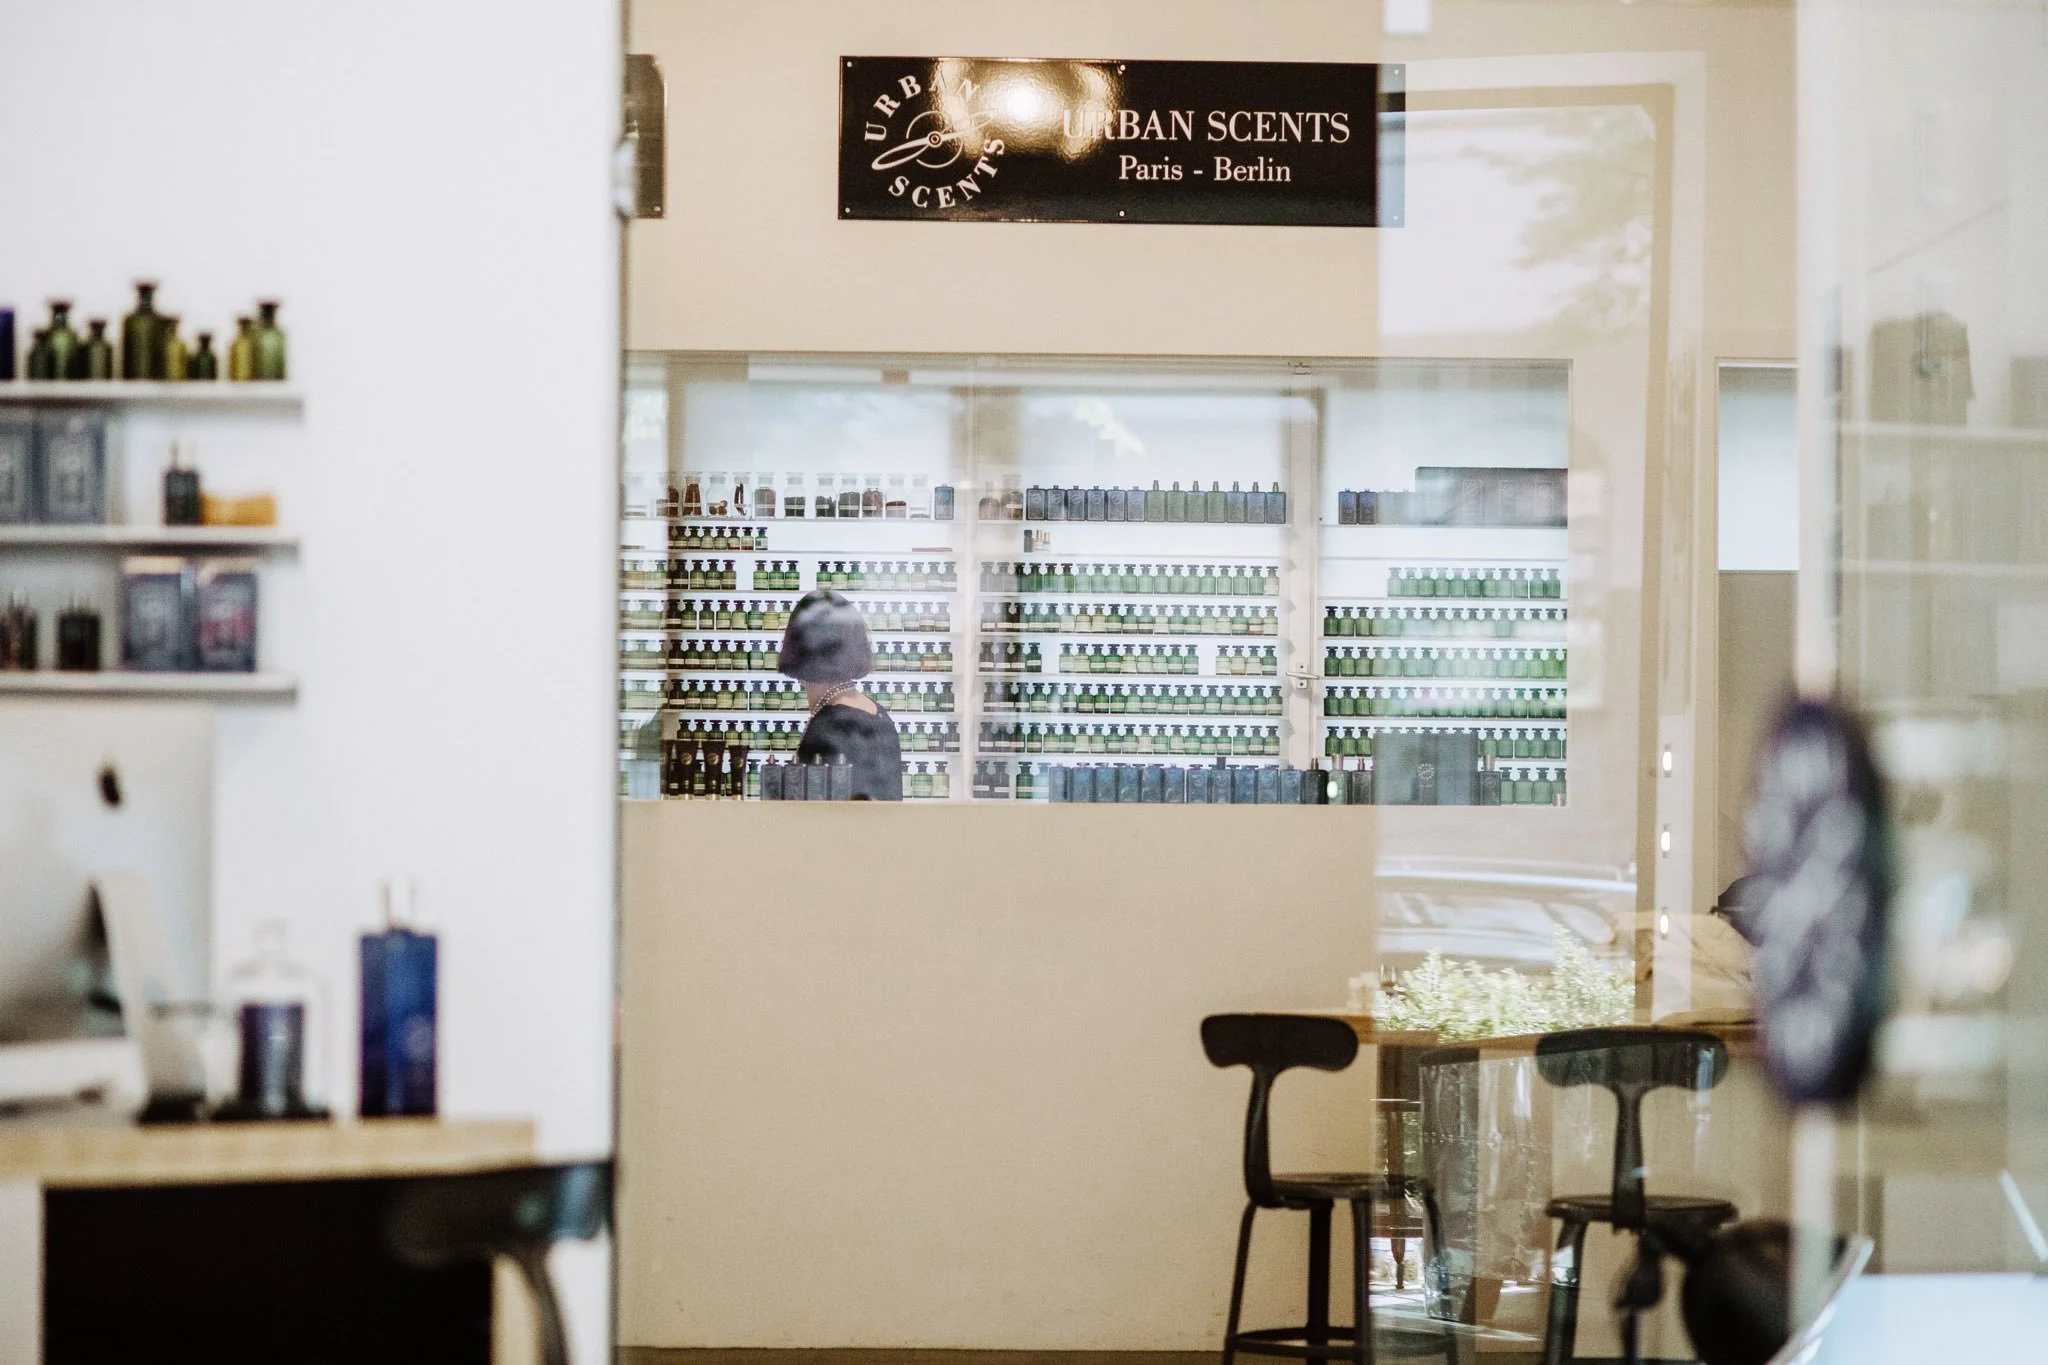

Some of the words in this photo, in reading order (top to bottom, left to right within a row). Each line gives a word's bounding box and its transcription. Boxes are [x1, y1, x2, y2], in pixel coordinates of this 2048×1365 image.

[864, 74, 980, 142] URBAN
[1062, 109, 1195, 141] URBAN
[1206, 110, 1350, 143] SCENTS
[888, 138, 1005, 209] SCENTS
[1118, 154, 1183, 181] Paris
[1213, 156, 1291, 182] Berlin
